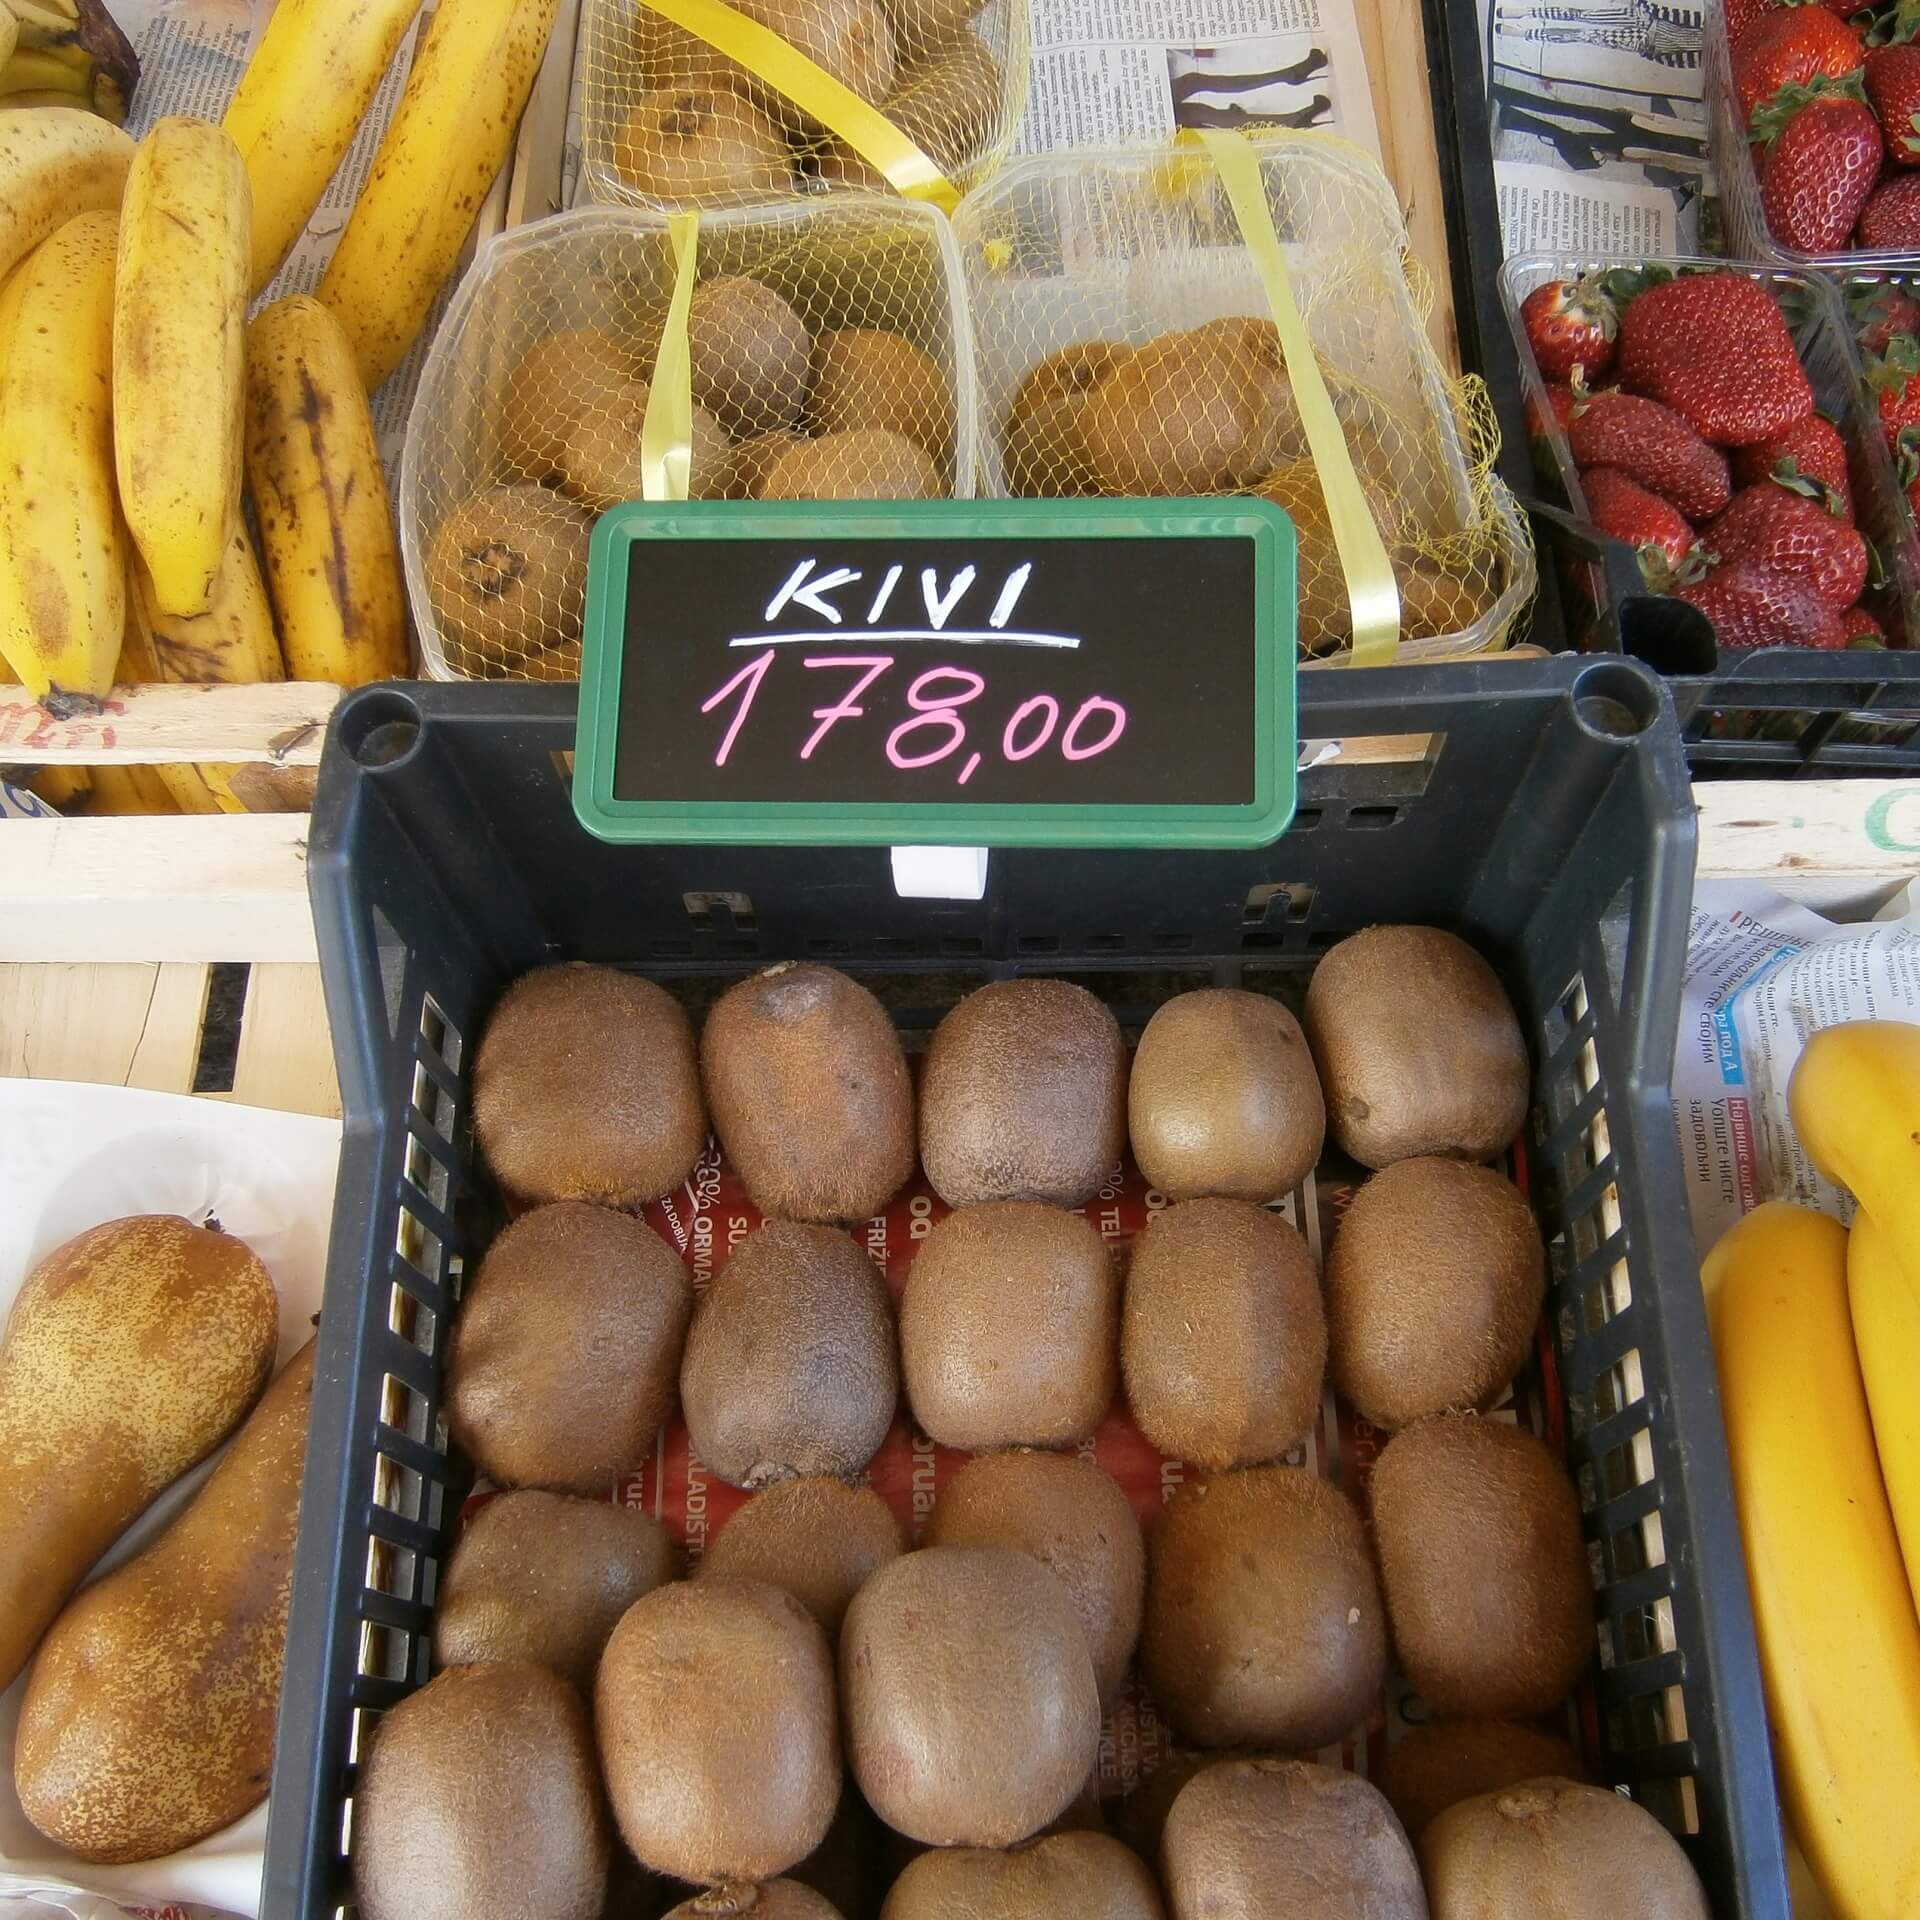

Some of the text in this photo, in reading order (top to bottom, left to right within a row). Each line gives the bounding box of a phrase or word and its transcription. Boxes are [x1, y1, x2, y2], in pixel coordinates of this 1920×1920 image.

[763, 556, 1033, 630] KIVI
[700, 649, 1127, 784] 178,00
[1699, 1012, 1716, 1064] својим
[1690, 1098, 1710, 1182] задовољни
[1710, 1098, 1736, 1204] Уопште нисте
[1730, 1099, 1749, 1162] Највише
